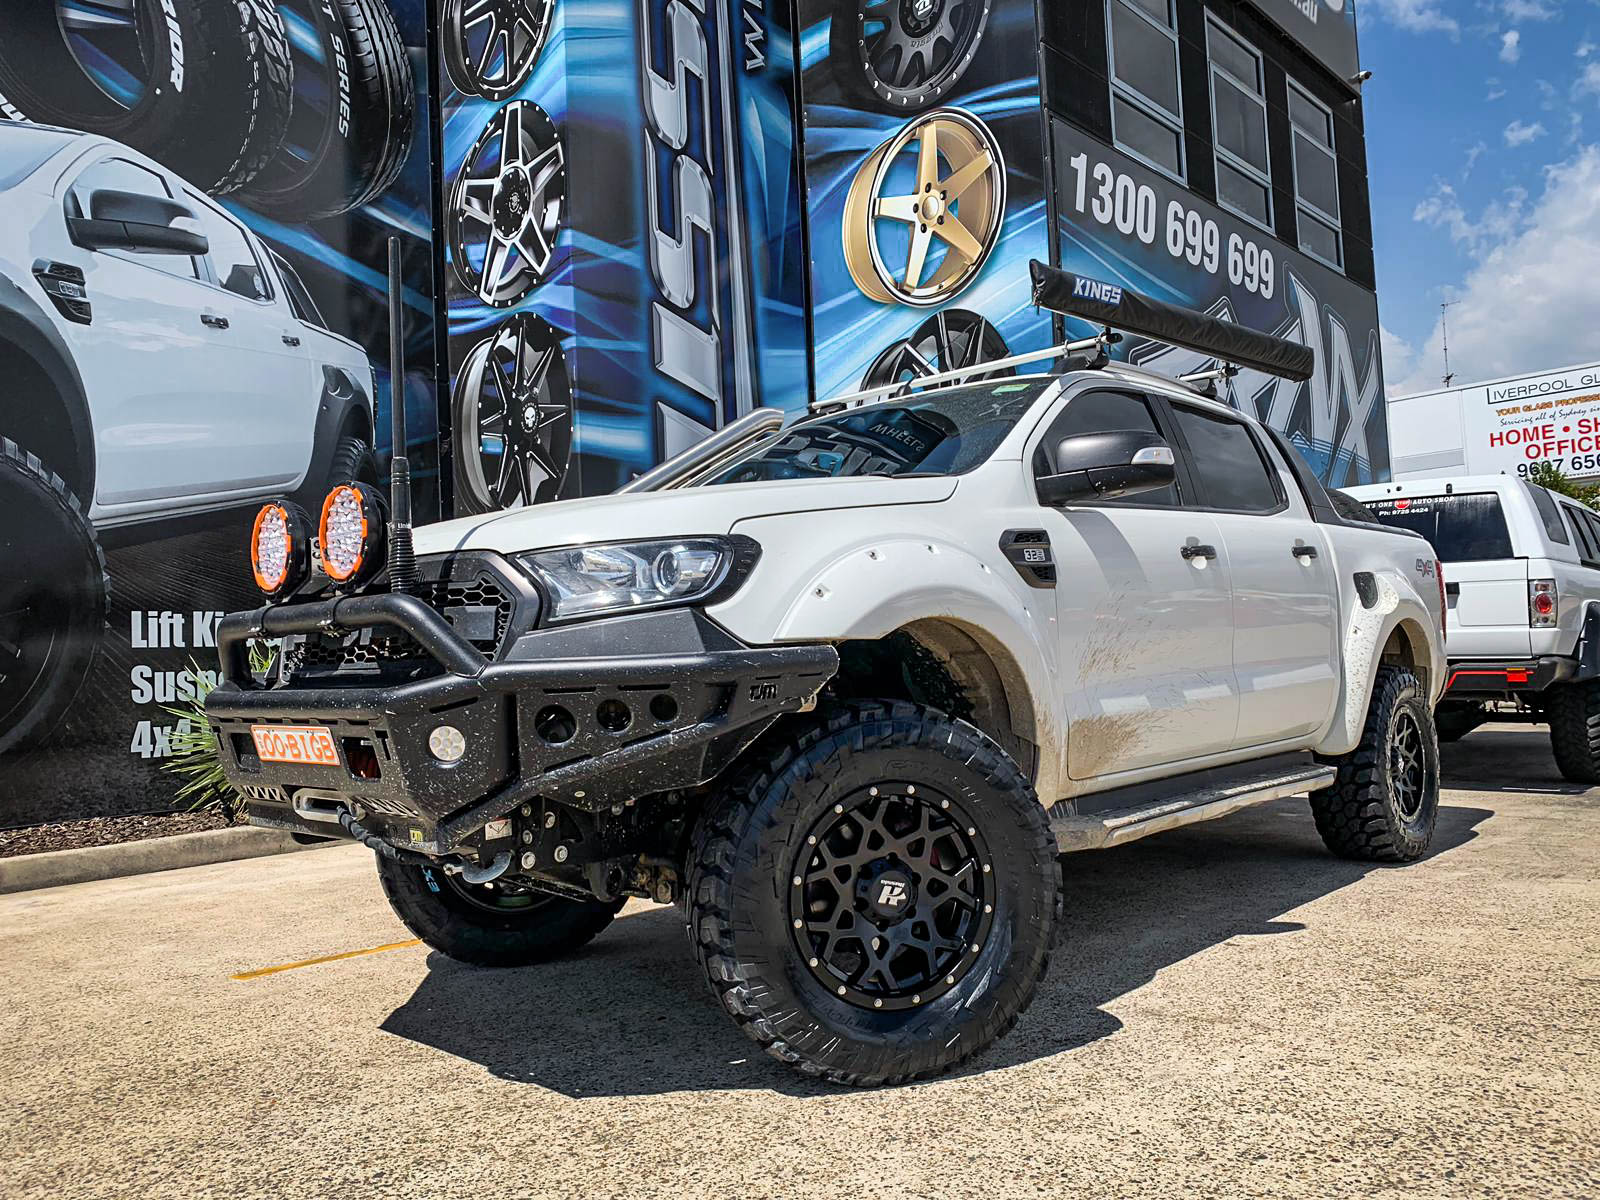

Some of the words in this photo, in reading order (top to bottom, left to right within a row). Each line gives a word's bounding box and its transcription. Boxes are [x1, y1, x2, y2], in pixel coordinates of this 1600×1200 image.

[329, 32, 351, 138] SERIES
[1070, 153, 1157, 244] 1300
[1166, 200, 1220, 274] 699
[1228, 233, 1275, 299] 699
[1073, 277, 1122, 304] KINGS
[1535, 412, 1547, 421] all
[1549, 411, 1556, 421] of
[1559, 408, 1587, 419] Sydney
[1489, 424, 1556, 447] HOME
[131, 610, 186, 649] Lift
